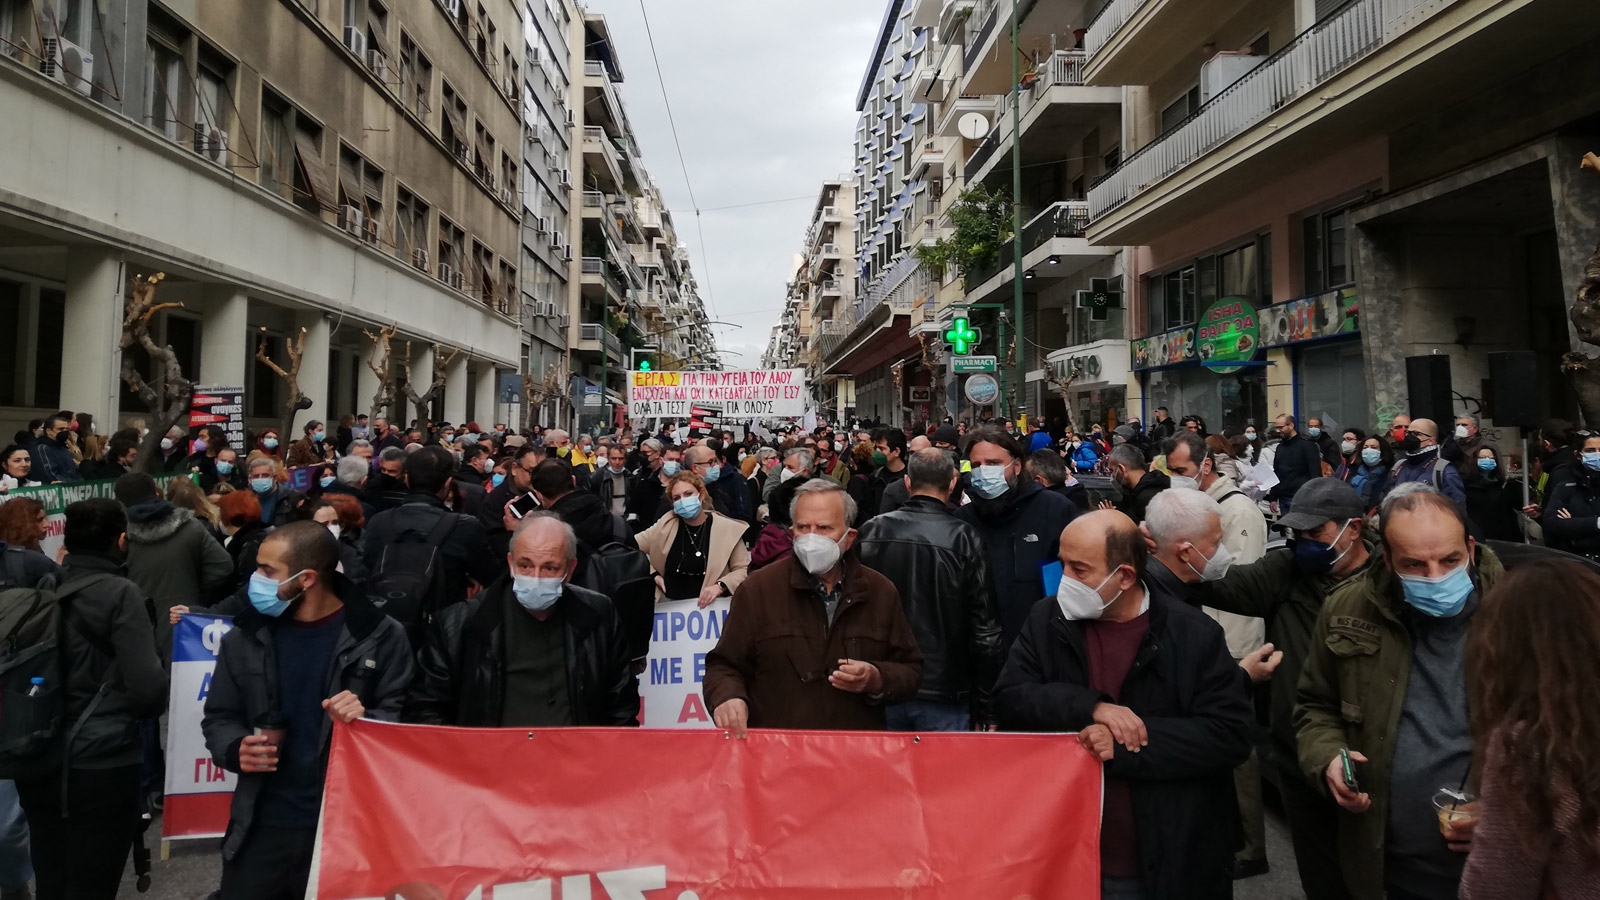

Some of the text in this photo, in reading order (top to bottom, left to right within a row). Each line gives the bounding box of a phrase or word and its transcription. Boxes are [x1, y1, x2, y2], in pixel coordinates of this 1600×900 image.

[1208, 301, 1243, 322] ISHA
[1199, 315, 1254, 340] BAIDOA
[682, 373, 698, 386] ΓΙΑ
[700, 372, 718, 386] ΤΗΝ
[721, 371, 748, 386] ΥΓΕΙΑ
[750, 371, 767, 385] ΤΟΥ
[769, 371, 792, 384] ΛΑΟΥ
[632, 385, 801, 401] ΕΝΙΣΧΥΣΗ ΚΑΙ ΟΧΙ ΚΑΤΕΔΑΦΙΣΗ ΤΟΥ ΕΣΥ
[653, 401, 663, 415] ΤΑ
[665, 401, 685, 415] ΤΕΣΤ
[726, 401, 739, 414] ΓΙΑ
[744, 400, 774, 414] ΟΛΟΥΣ
[650, 657, 683, 685] ΜΕ
[194, 758, 226, 783] ΓΙΑ
